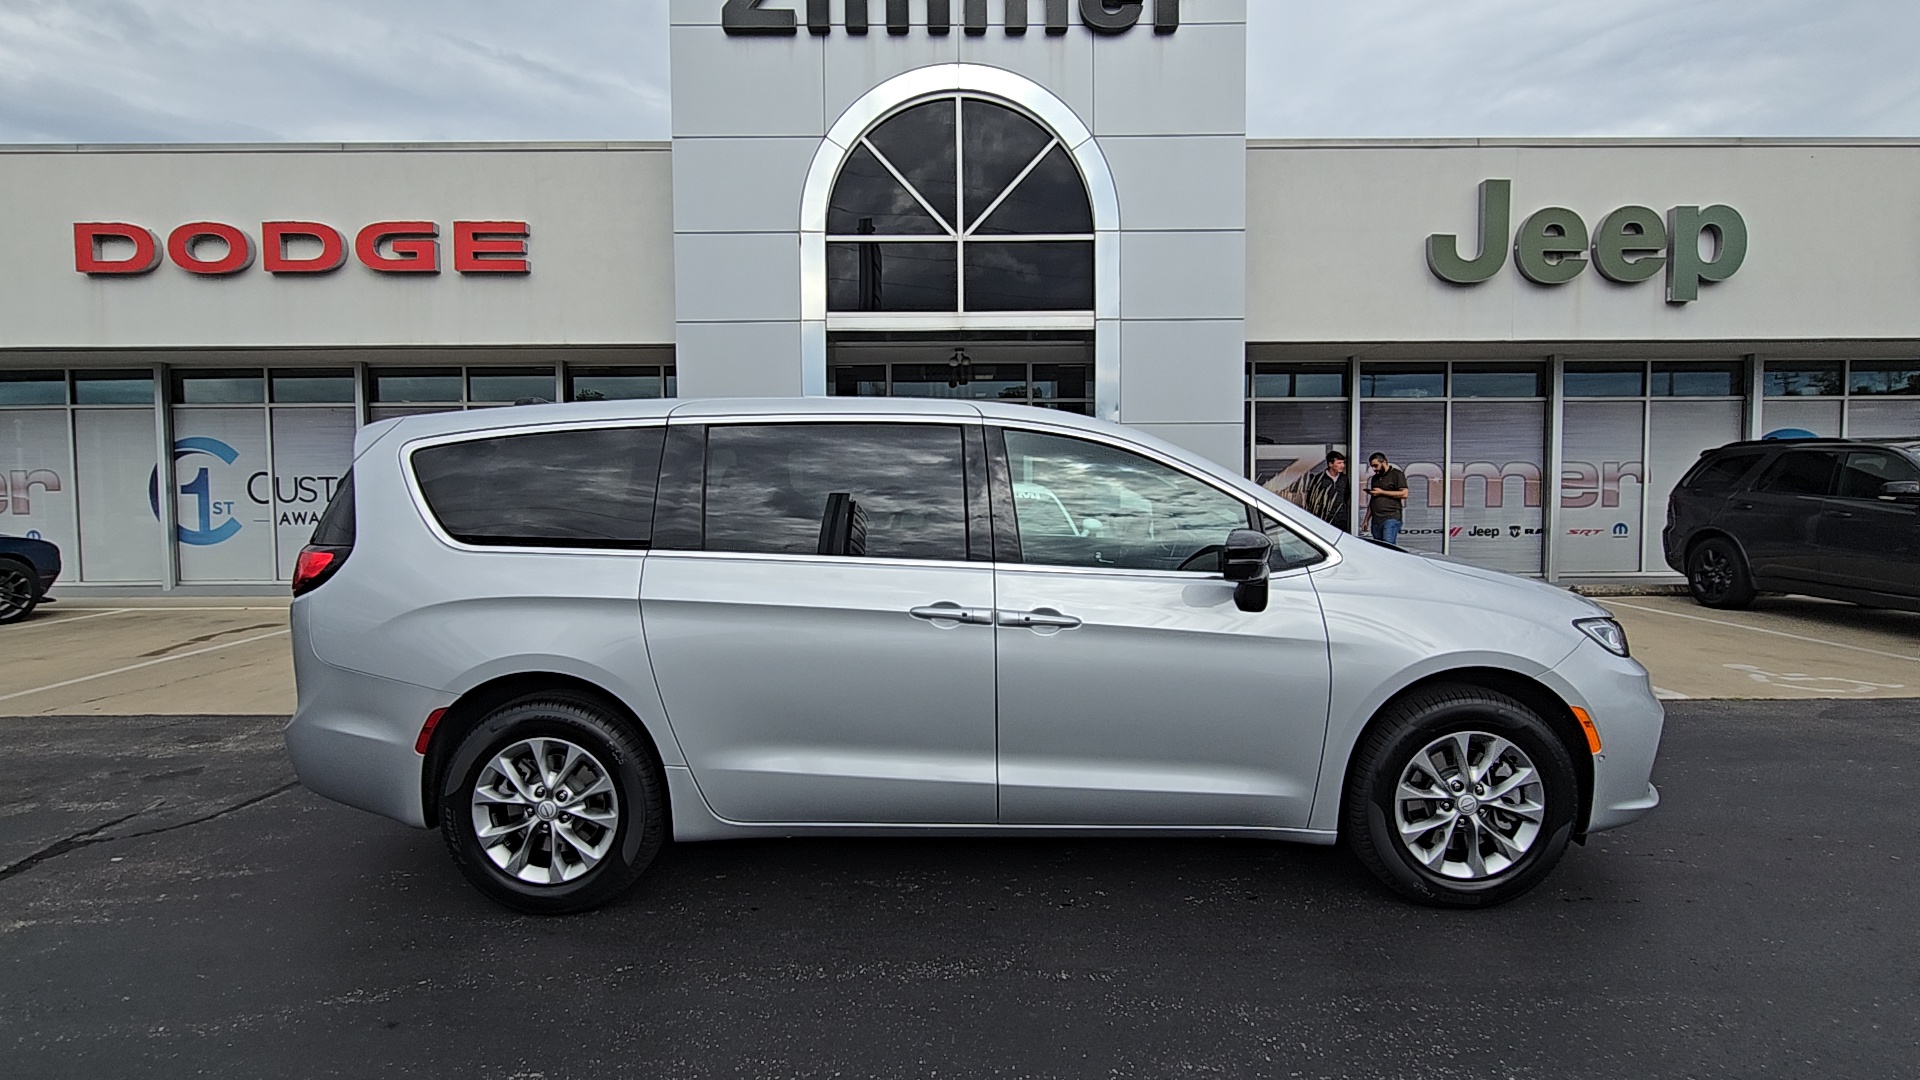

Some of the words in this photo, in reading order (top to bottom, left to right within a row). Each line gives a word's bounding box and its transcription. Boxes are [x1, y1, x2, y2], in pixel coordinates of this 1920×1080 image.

[73, 220, 531, 277] DODGE
[1425, 179, 1748, 304] Jeep
[247, 471, 344, 504] CUST
[1468, 525, 1500, 538] Jeep
